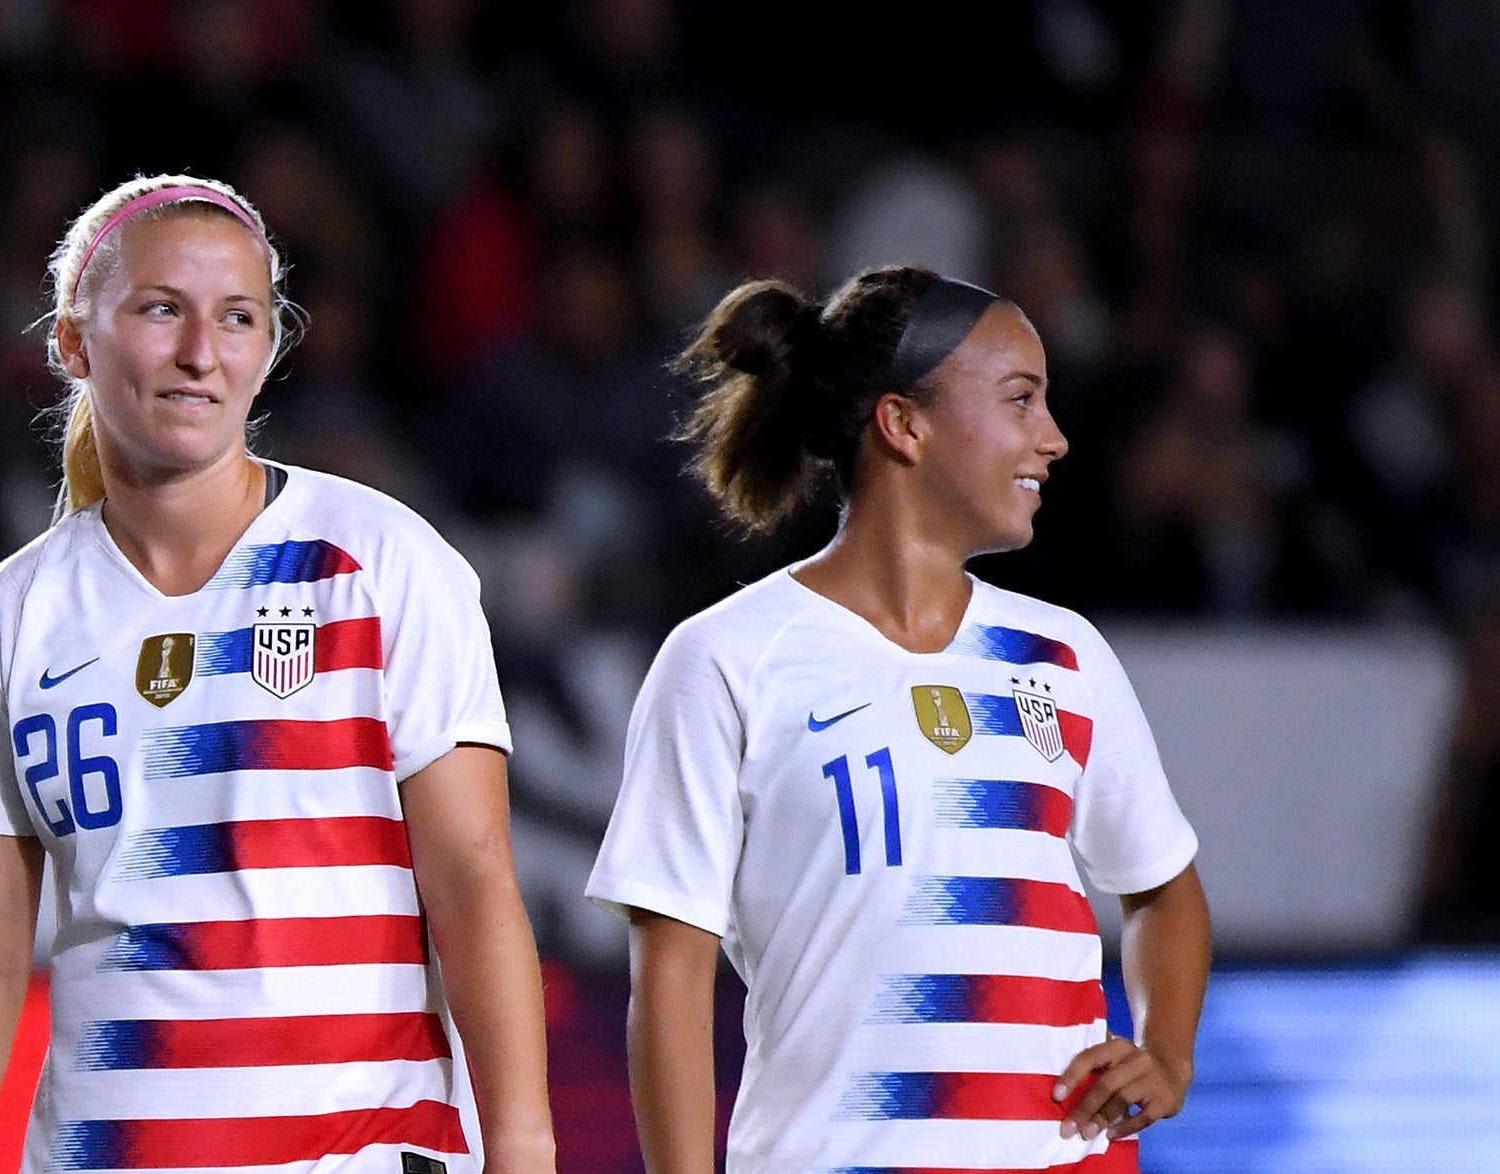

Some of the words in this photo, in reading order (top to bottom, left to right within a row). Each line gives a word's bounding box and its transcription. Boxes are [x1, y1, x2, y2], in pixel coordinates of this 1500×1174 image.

[258, 629, 310, 656] USA
[149, 678, 177, 690] FIFA
[1017, 695, 1055, 723] USA
[933, 727, 961, 738] FIFA
[13, 702, 123, 837] 26
[822, 746, 902, 875] 11
